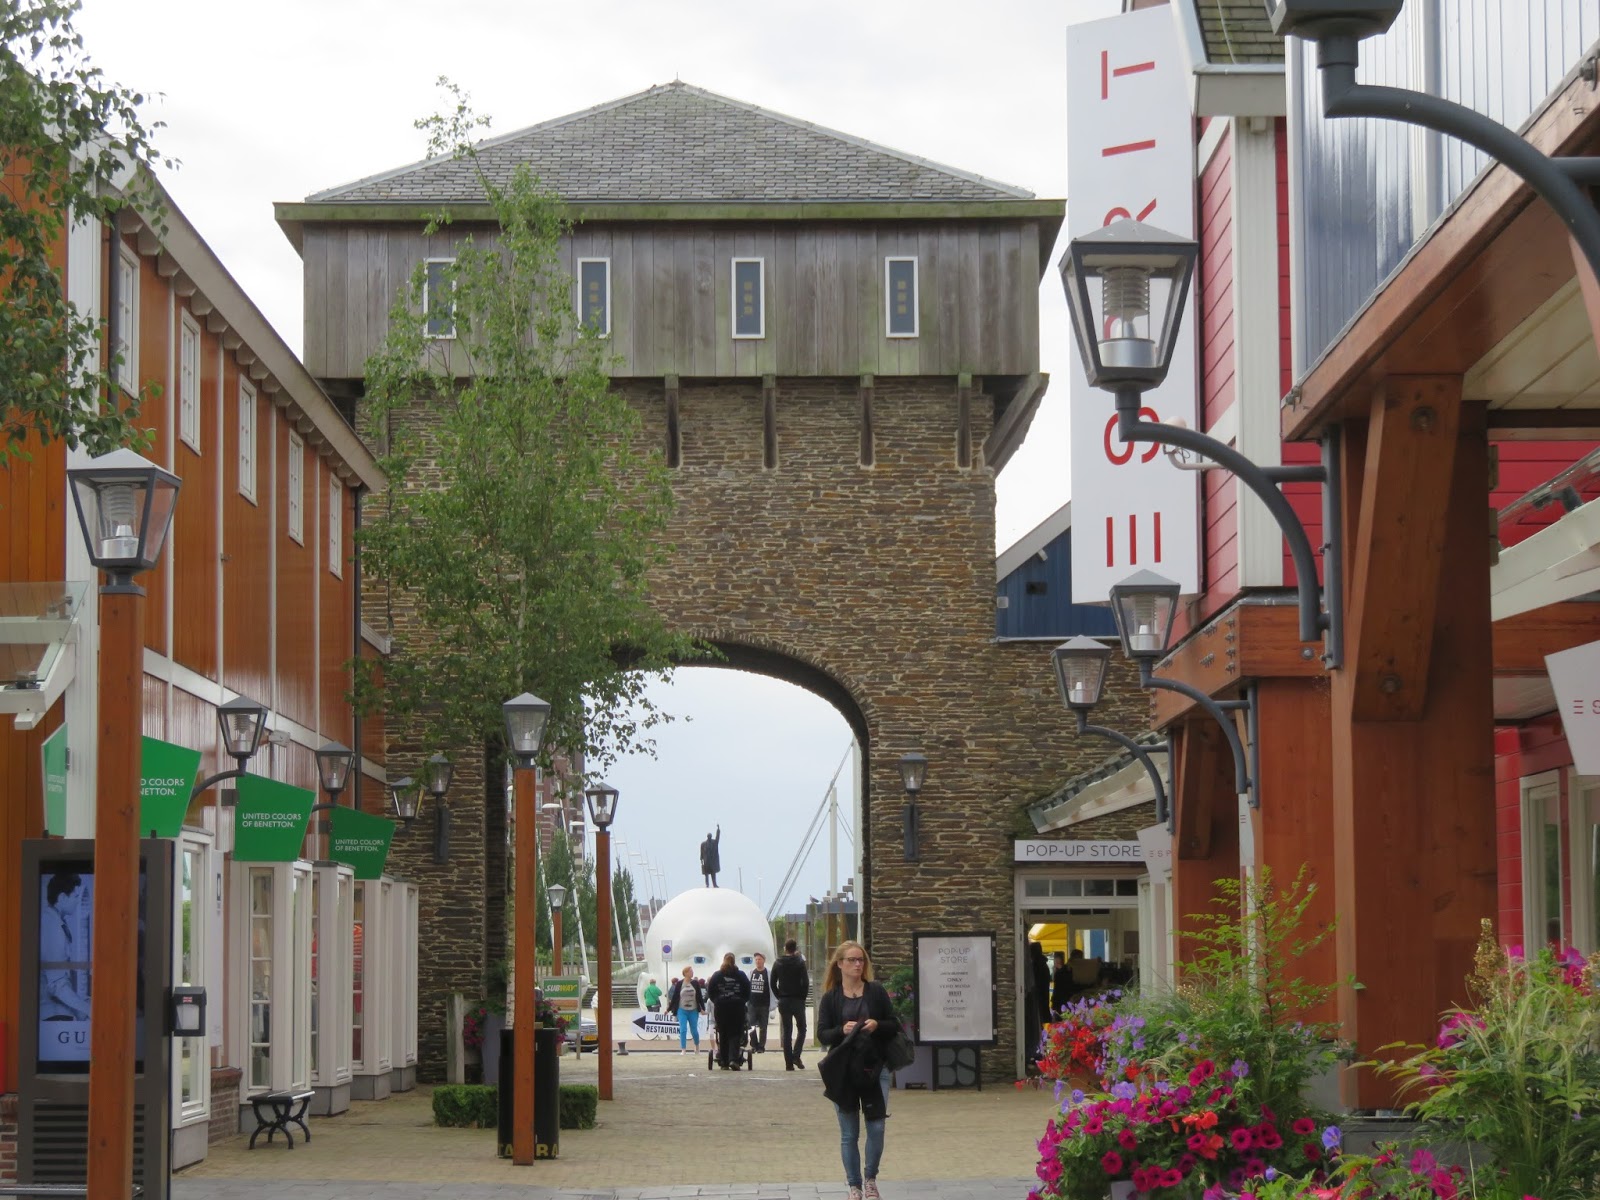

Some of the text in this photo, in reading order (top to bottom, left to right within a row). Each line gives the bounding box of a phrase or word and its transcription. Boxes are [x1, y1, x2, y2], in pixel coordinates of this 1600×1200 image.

[1101, 50, 1162, 568] ESIT
[148, 778, 185, 786] COLORS
[140, 787, 177, 796] NETTON.
[242, 812, 302, 821] UNITED COLORS
[242, 820, 295, 828] OF BENETTON.
[335, 838, 359, 846] UNITED
[1026, 844, 1141, 857] POP-UP STORE
[938, 947, 971, 955] POP-UP
[940, 956, 968, 964] STORE
[545, 984, 577, 992] SUBWAY
[655, 1014, 673, 1022] OUTLE
[645, 1025, 681, 1034] RESTAURAN
